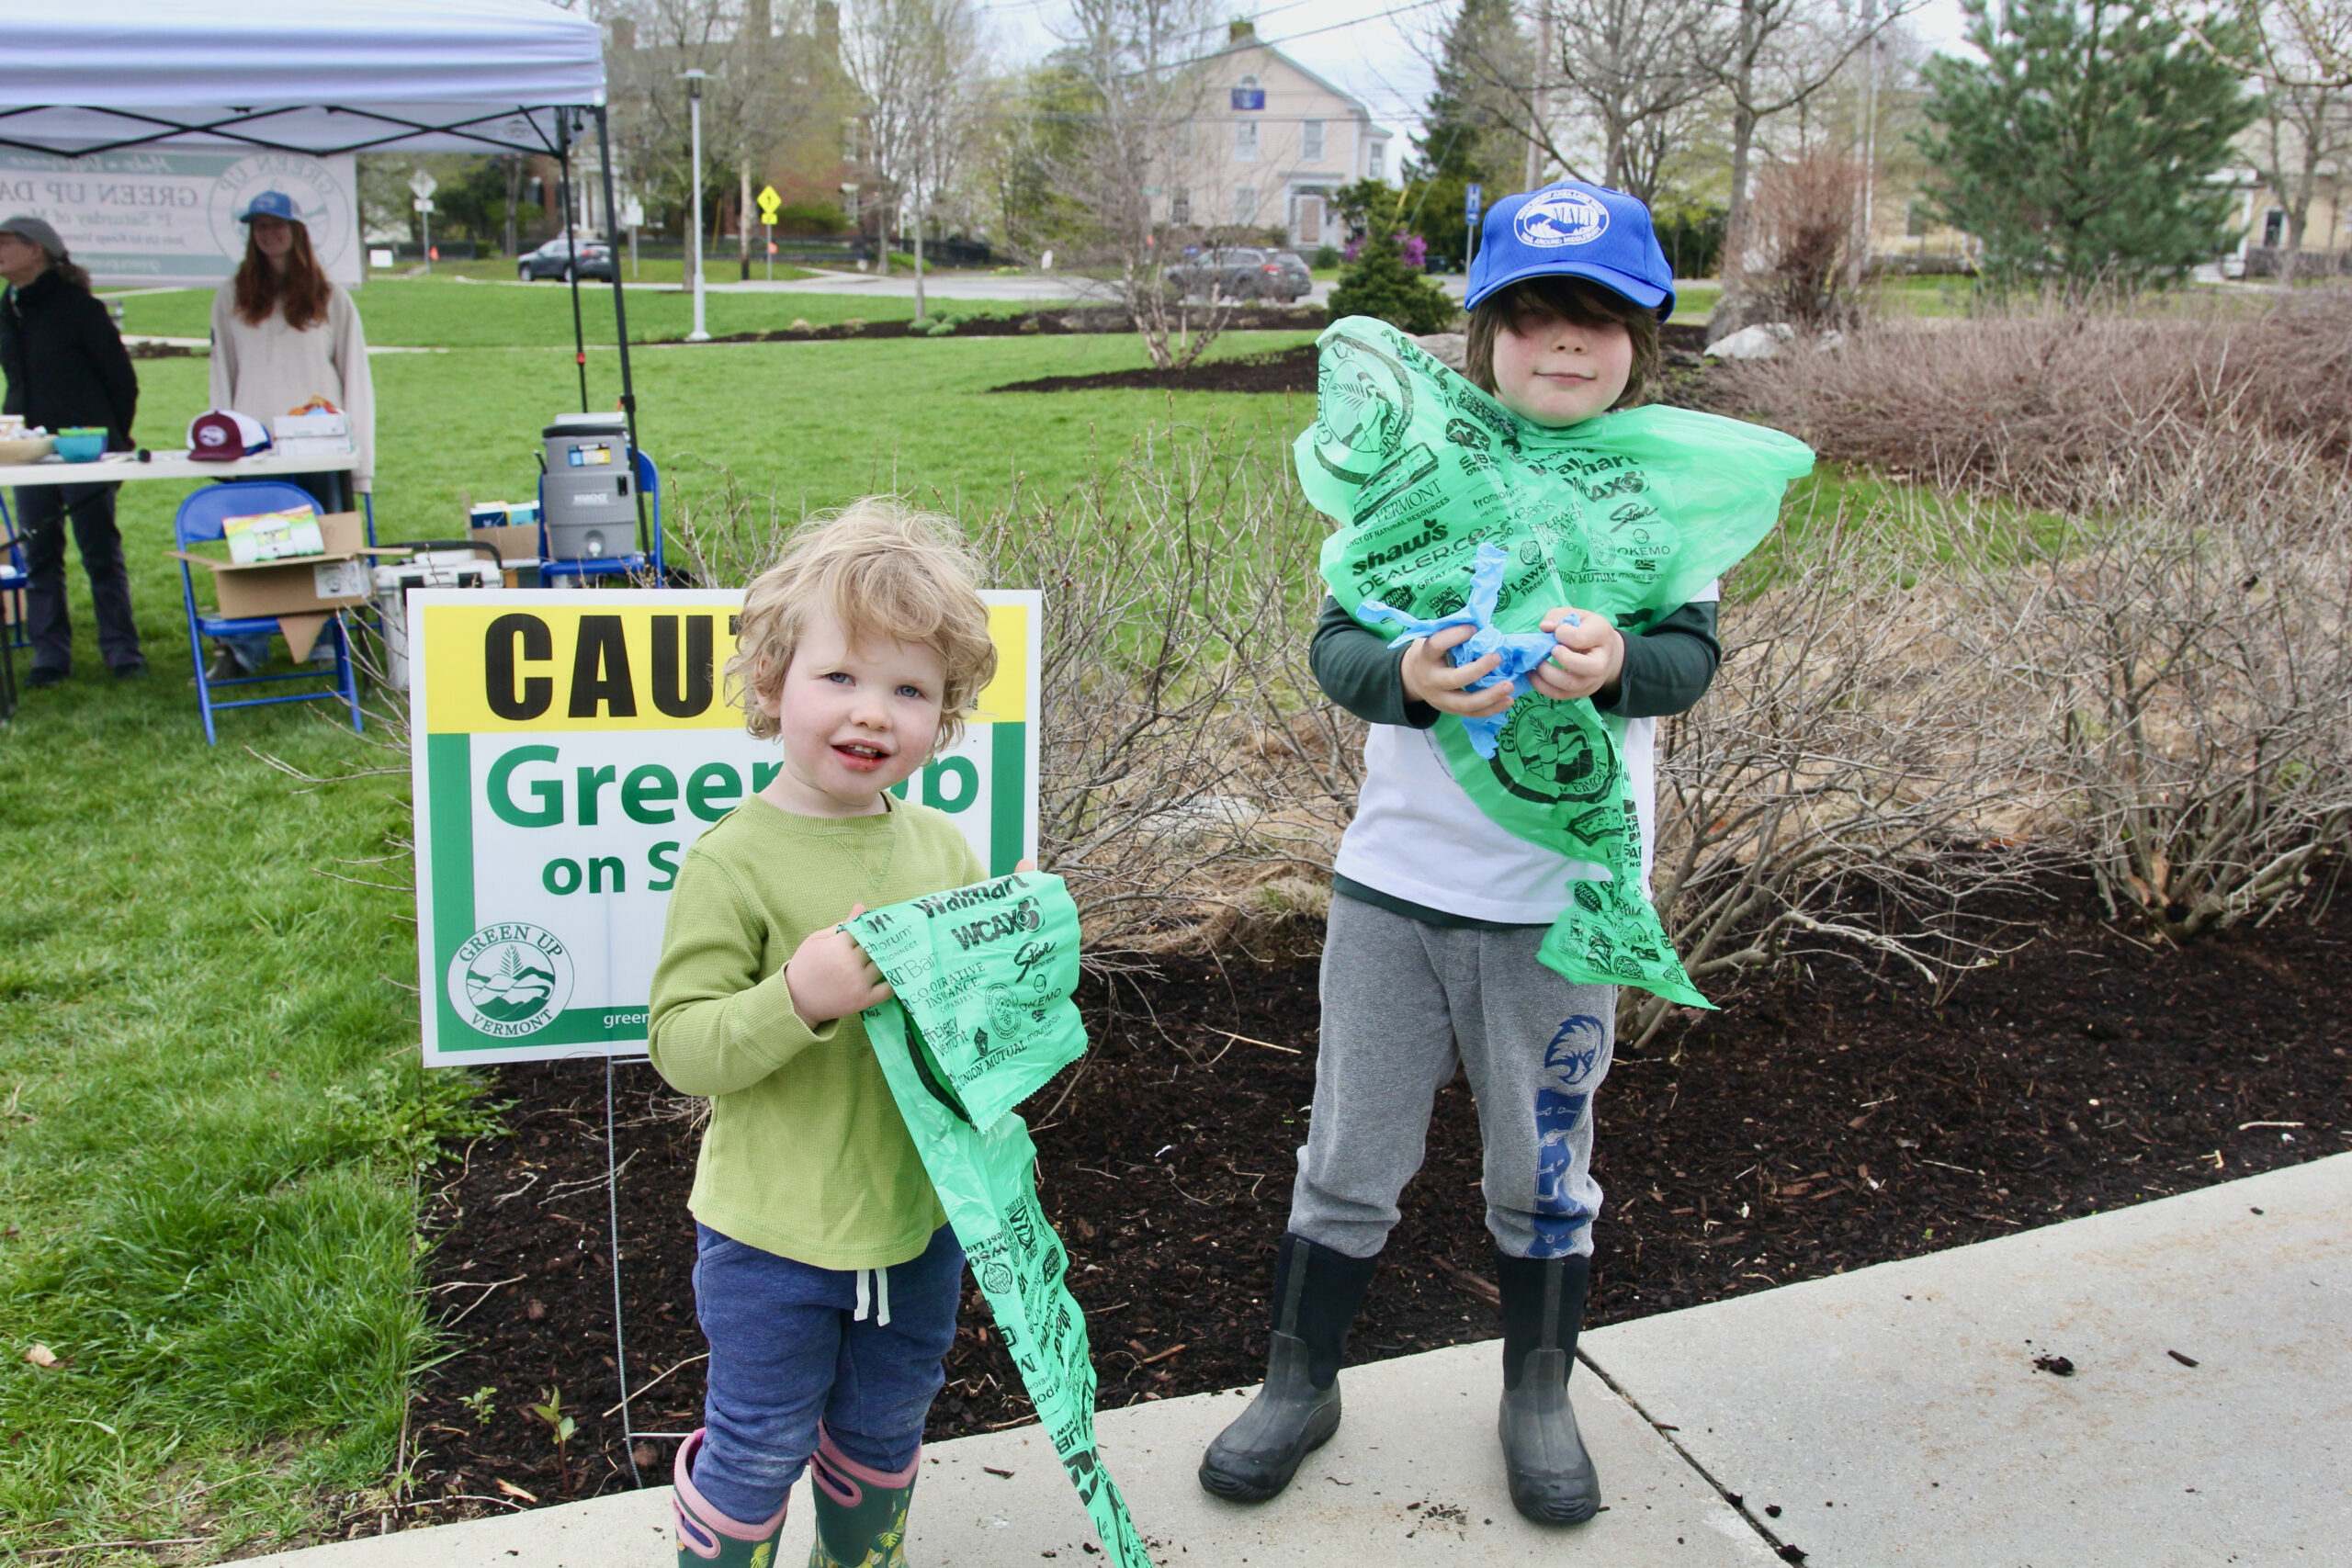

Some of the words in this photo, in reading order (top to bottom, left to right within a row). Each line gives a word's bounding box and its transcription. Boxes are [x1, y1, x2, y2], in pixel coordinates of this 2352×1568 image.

[1374, 478, 1442, 523] VERMONT
[1407, 496, 1451, 521] RESOURCES
[1617, 545, 1670, 556] OKEMO
[1577, 572, 1617, 585] MUTUAL
[487, 744, 785, 828] Gree
[542, 855, 626, 896] on
[910, 874, 1030, 919] Walmart
[459, 925, 531, 962] GREEN
[537, 932, 563, 957] UP
[1019, 987, 1062, 1012] OKEMO
[471, 1008, 553, 1036] VERMONT
[958, 1063, 984, 1087] UNION
[984, 1040, 1028, 1070] MUTUAL
